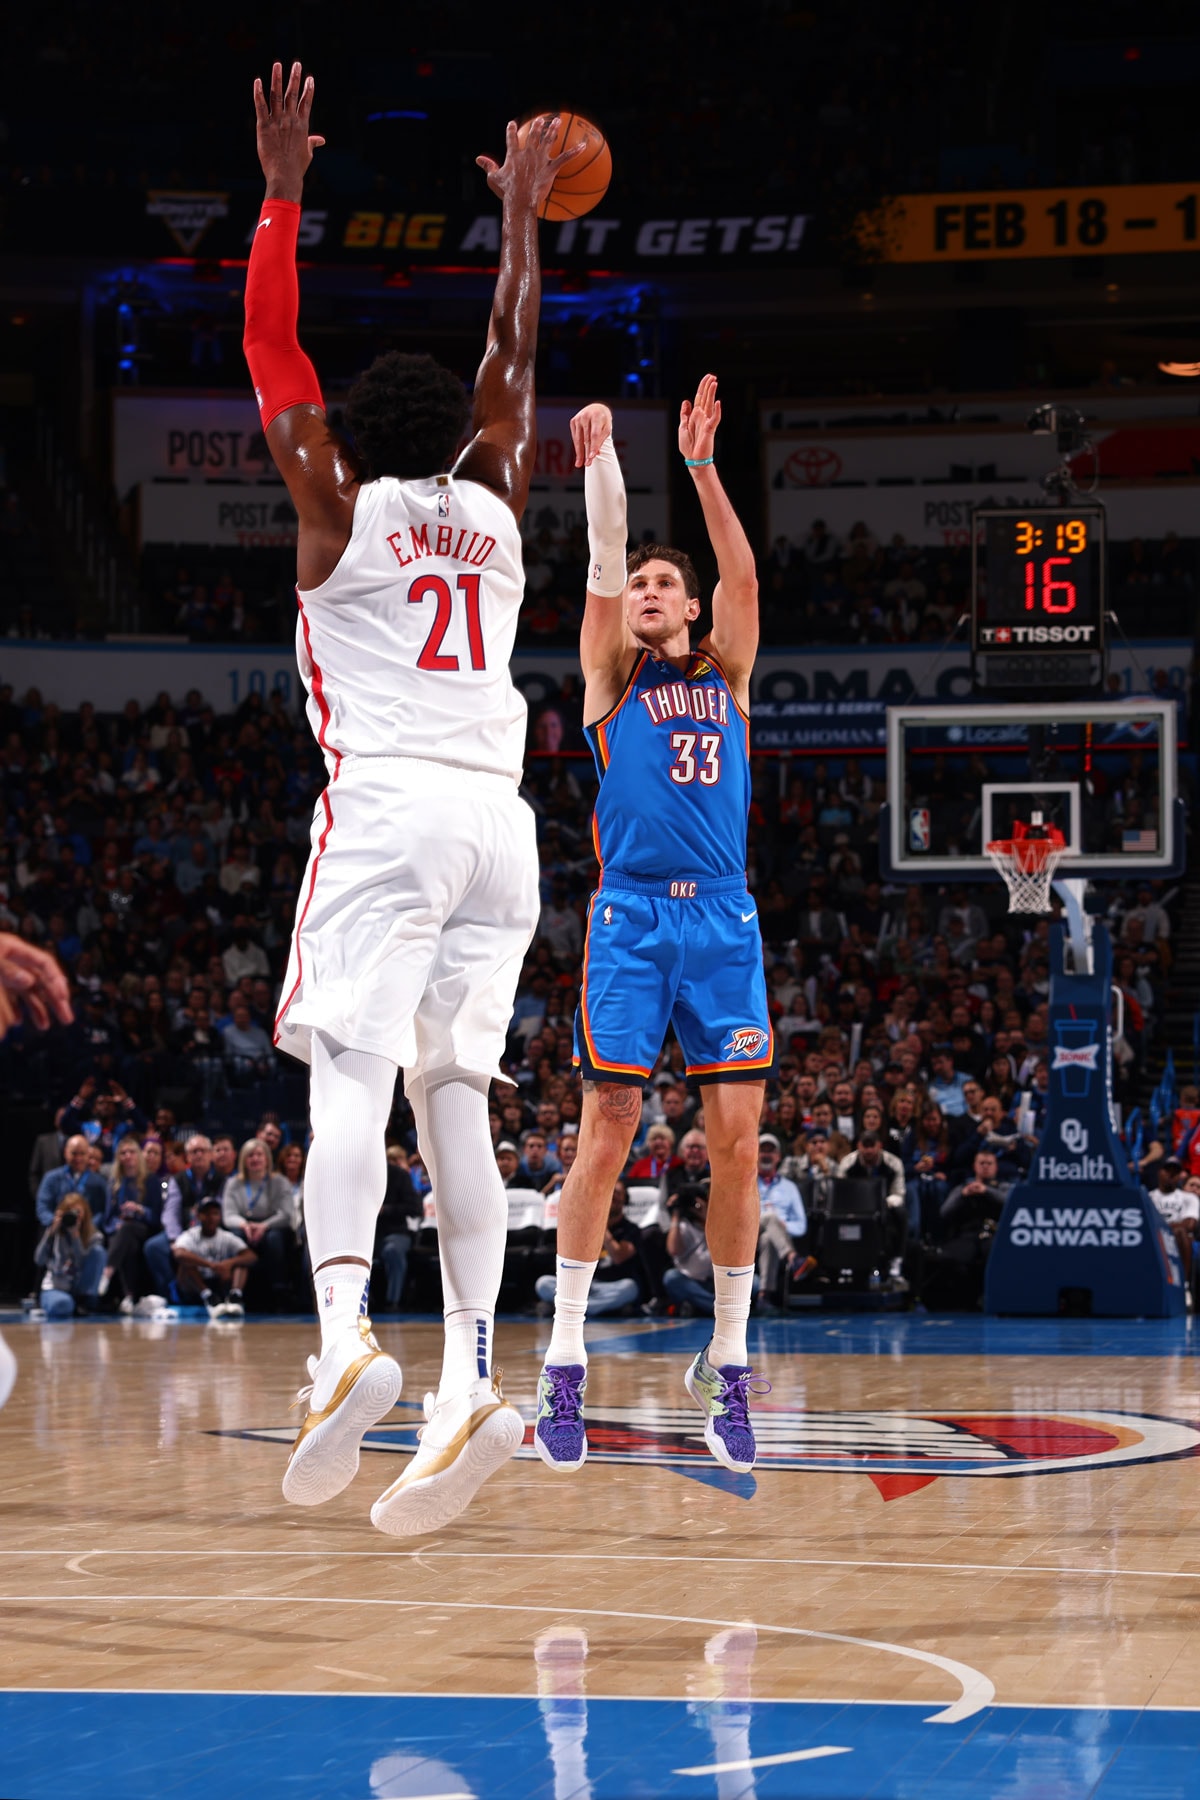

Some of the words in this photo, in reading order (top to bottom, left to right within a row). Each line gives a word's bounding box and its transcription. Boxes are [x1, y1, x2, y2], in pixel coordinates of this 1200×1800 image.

[341, 211, 448, 250] BIG
[459, 214, 502, 253] A
[555, 219, 622, 255] IT
[635, 212, 814, 257] GETS!
[934, 203, 1026, 251] FEB
[1046, 198, 1108, 247] 18
[167, 430, 243, 467] POST
[218, 502, 268, 527] POST
[386, 523, 497, 568] EMBIID
[1014, 520, 1087, 555] 3:19
[1024, 556, 1077, 614] 16
[407, 573, 487, 672] 21
[1012, 625, 1096, 643] TISSOT
[755, 728, 875, 746] OKLAHOMAN
[670, 731, 722, 786] 33
[670, 881, 698, 898] OKC
[734, 1033, 760, 1052] OKC
[1059, 1051, 1092, 1062] SONIC
[1060, 1118, 1088, 1153] OU
[1038, 1155, 1114, 1181] Health
[1011, 1208, 1143, 1228] ALWAYS
[1010, 1229, 1143, 1247] ONWARD
